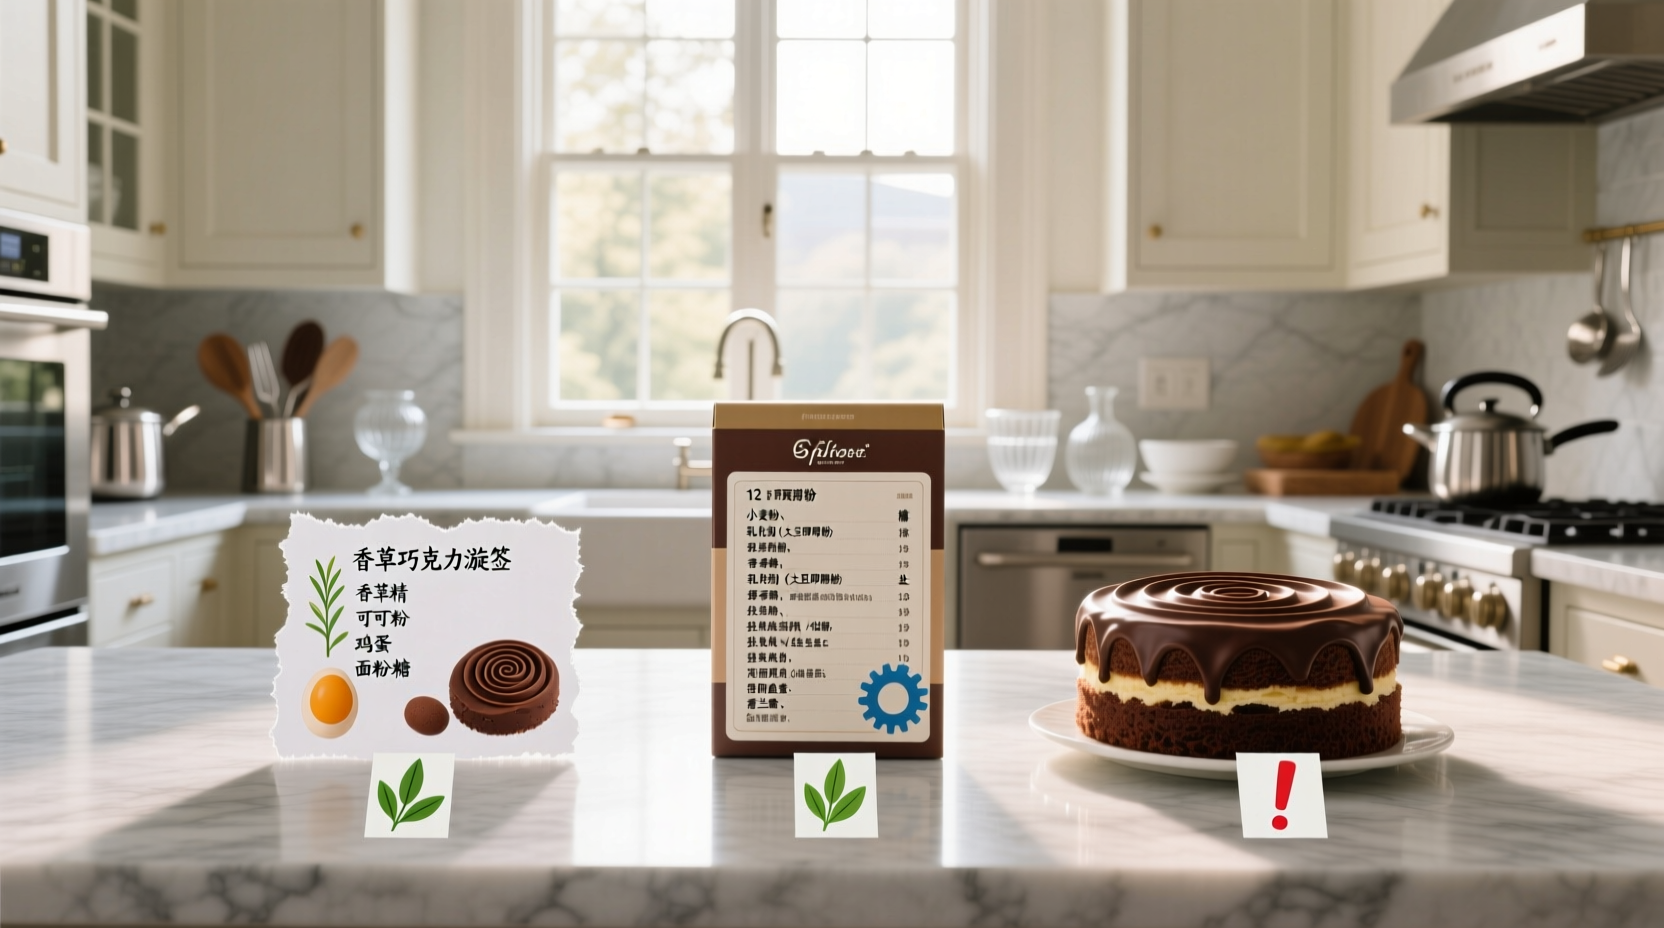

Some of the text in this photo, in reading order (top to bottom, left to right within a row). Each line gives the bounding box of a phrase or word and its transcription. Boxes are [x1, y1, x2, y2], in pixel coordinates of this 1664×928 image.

[746, 488, 762, 501] 12
[355, 609, 410, 628] 可可粉
[354, 634, 392, 654] 鸡蛋
[354, 658, 411, 679] 面粉糖
